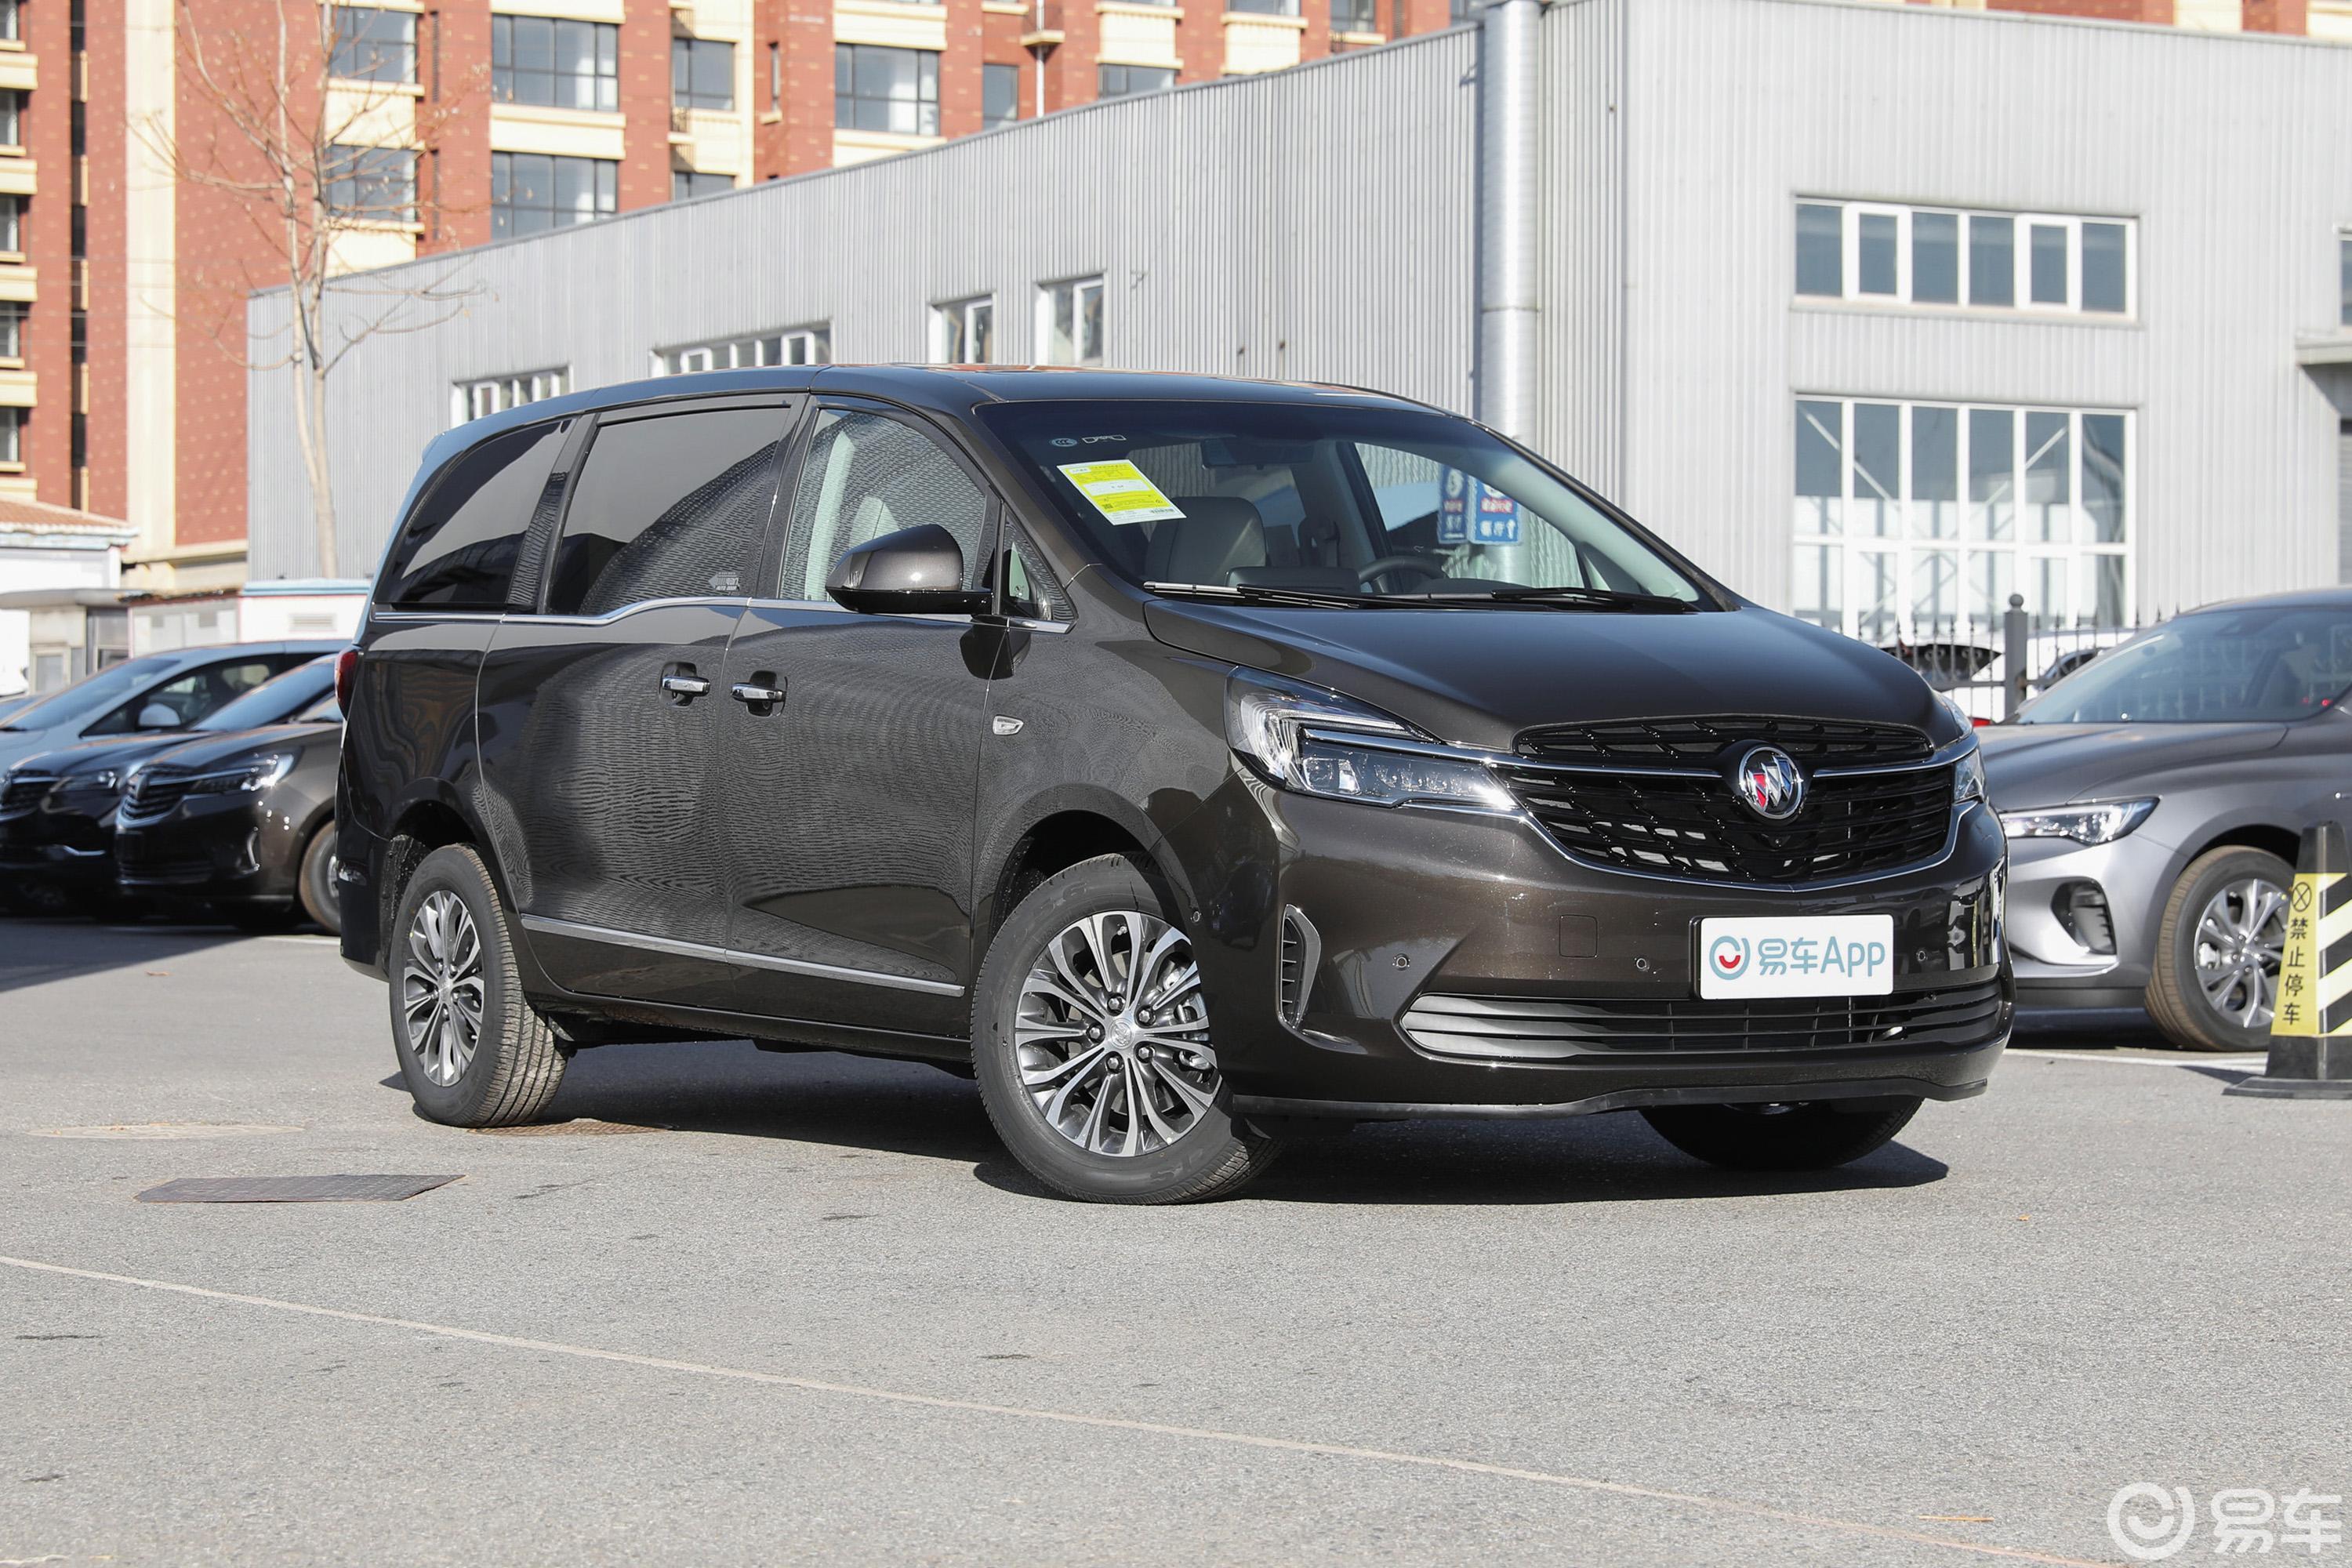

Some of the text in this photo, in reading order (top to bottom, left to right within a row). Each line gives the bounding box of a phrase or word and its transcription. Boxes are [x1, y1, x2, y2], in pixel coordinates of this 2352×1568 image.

[1758, 936, 1886, 978] 易车App
[2282, 917, 2309, 1025] 禁止停车
